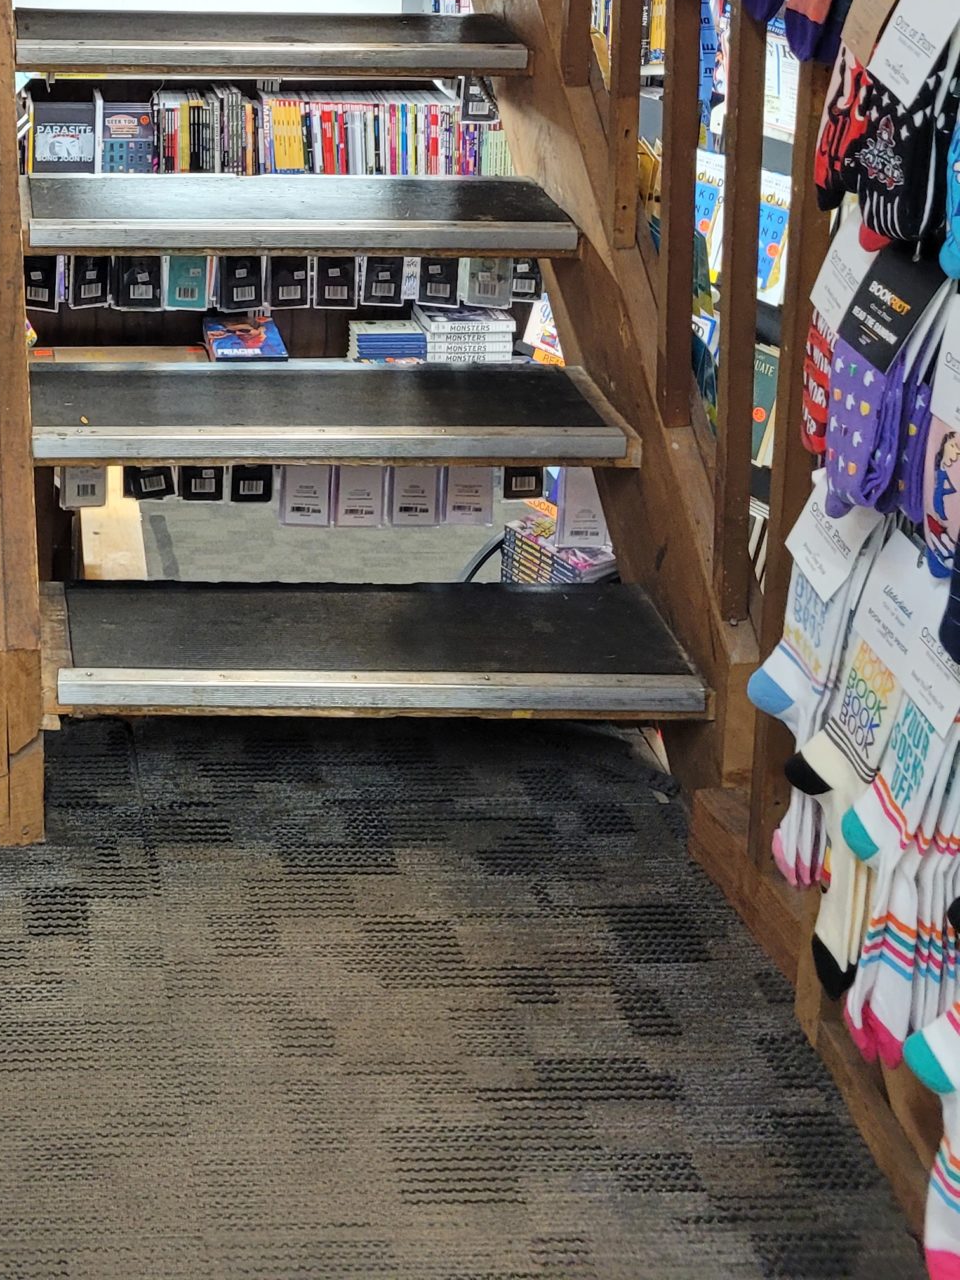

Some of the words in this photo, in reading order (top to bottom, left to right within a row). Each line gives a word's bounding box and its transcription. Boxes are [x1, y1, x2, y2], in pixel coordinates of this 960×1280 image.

[37, 126, 93, 134] PARASITE
[449, 324, 491, 332] MONSTERS
[446, 334, 487, 342] MONSTERS
[446, 344, 487, 352] MONSTERS
[446, 354, 487, 362] MONSTERS
[529, 499, 556, 517] LOCAL
[848, 668, 887, 723] BOOK
[844, 681, 881, 743] BOOK
[839, 704, 874, 759] BOOK
[891, 765, 913, 810] OFF
